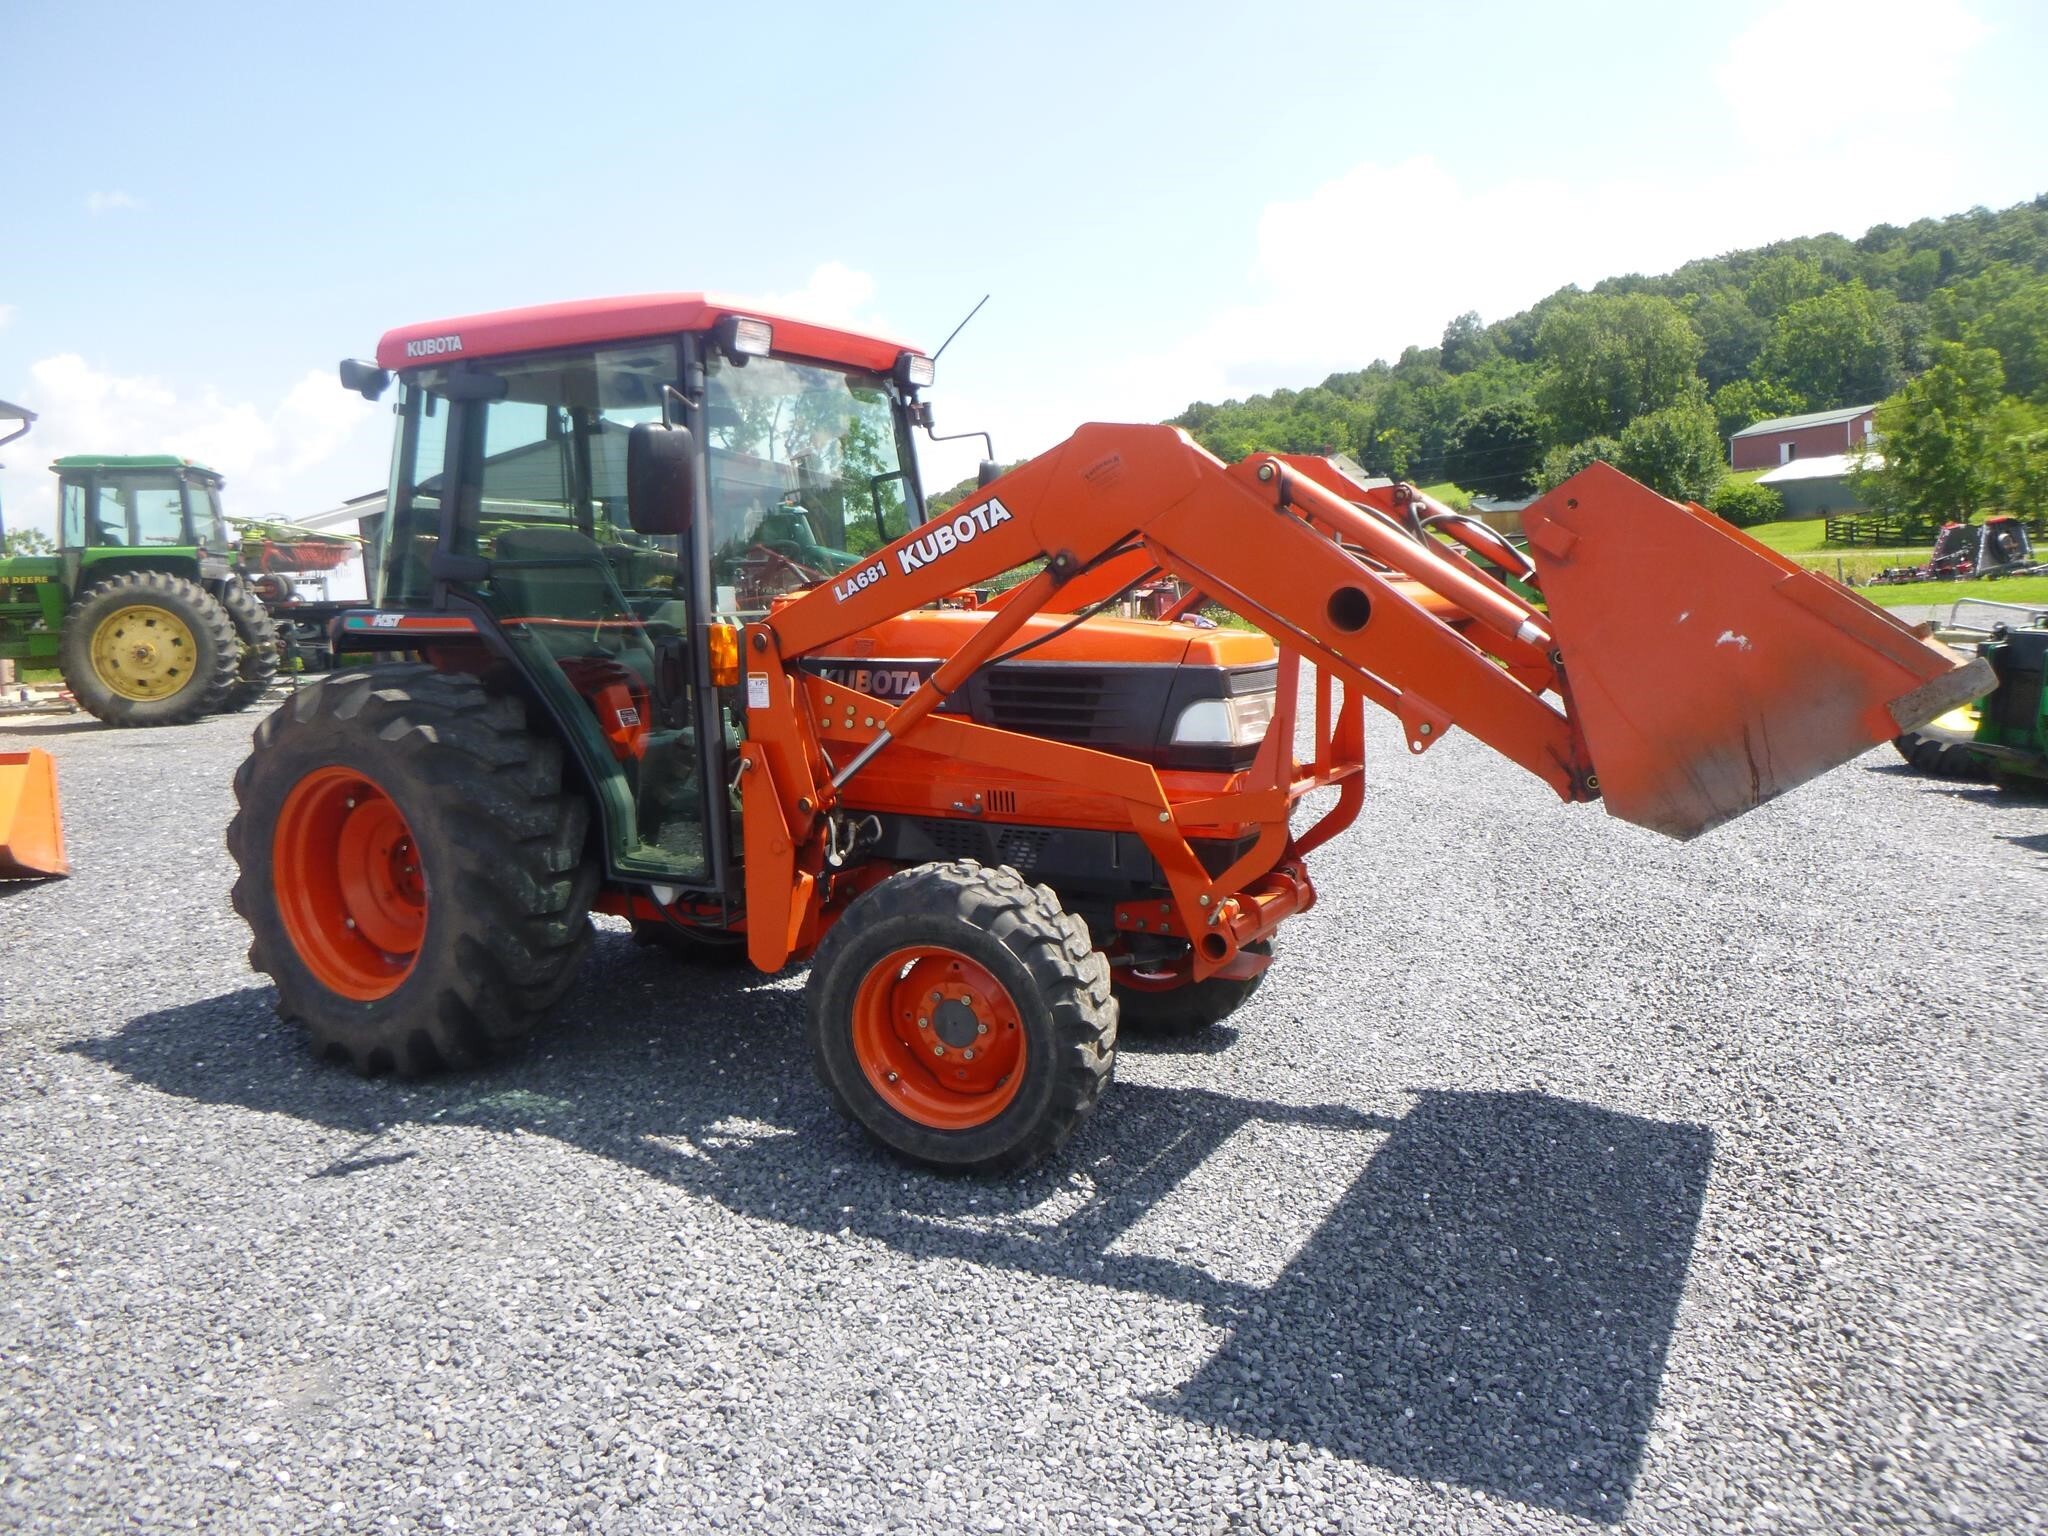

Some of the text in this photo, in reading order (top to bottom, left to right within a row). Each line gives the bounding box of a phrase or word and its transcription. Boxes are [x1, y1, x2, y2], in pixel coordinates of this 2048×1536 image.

[407, 335, 462, 357] KUBOTA
[833, 497, 1013, 603] LA681 KUBOTA
[12, 576, 49, 584] DEERE
